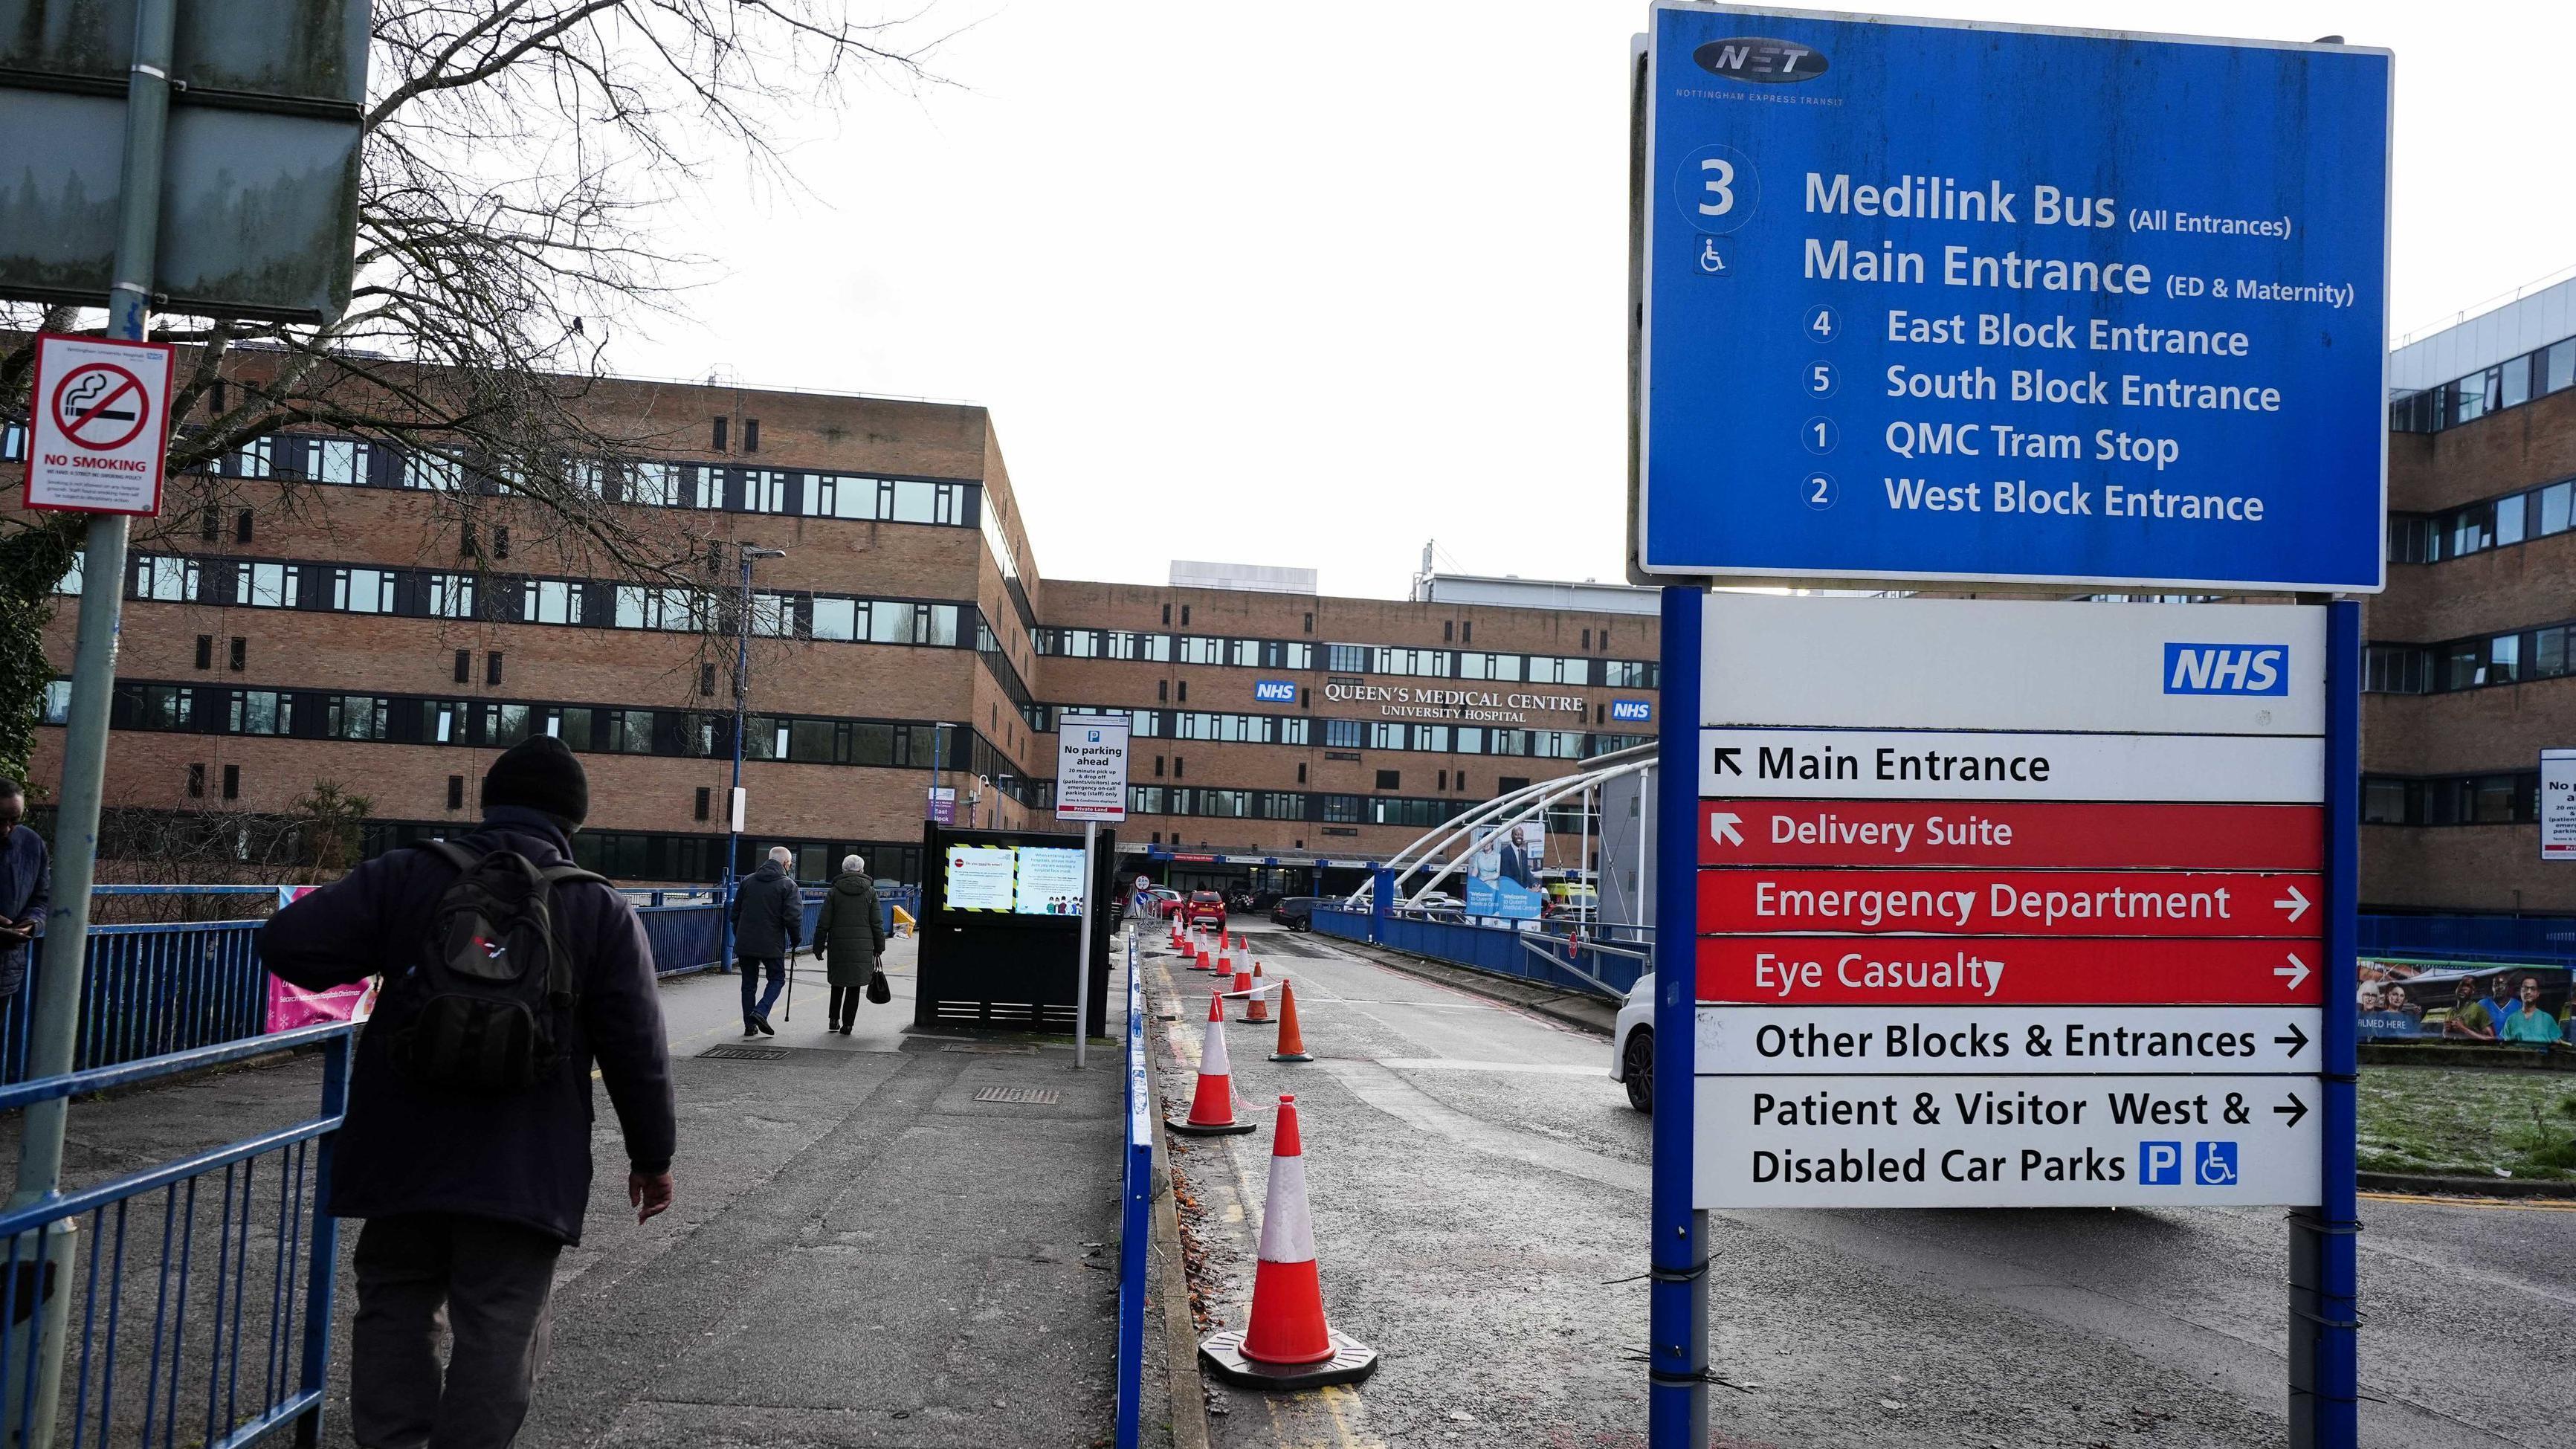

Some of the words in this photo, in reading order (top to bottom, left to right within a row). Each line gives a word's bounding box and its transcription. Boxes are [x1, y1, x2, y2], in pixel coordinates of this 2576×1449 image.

[1715, 45, 1810, 73] NET
[1676, 88, 1744, 100] NOTTINGHAM
[1749, 94, 1796, 104] EXPRESS
[1801, 97, 1844, 106] TRANSIT
[1699, 158, 1734, 216] 3
[1806, 172, 2017, 223] Medilink
[2034, 185, 2115, 228] Bus
[2129, 208, 2167, 233] (All
[2175, 212, 2291, 240] Entrances)
[1804, 238, 1924, 283] Main
[1944, 245, 2151, 294] Entrance
[2166, 274, 2204, 299] (ED
[2212, 278, 2228, 298] &
[2236, 280, 2354, 309] Maternity)
[1813, 311, 1831, 335] 4
[1888, 310, 1965, 344] East
[1978, 313, 2076, 349] Block
[2090, 319, 2249, 356] Entrance
[1814, 367, 1829, 392] 5
[1887, 364, 1996, 400] South
[2012, 369, 2108, 404] Block
[2123, 375, 2281, 412] Entrance
[45, 454, 68, 465] NO
[73, 456, 146, 472] SMOKING
[1814, 422, 1825, 447] 1
[1885, 421, 1979, 459] QMC
[1990, 425, 2081, 459] Tram
[2096, 429, 2179, 471] Stop
[1811, 478, 1827, 503] 2
[1884, 477, 1981, 512] West
[1994, 480, 2092, 515] Block
[2105, 485, 2264, 521] Entrance
[2171, 649, 2281, 691] NHS
[1256, 683, 1294, 699] NHS
[1325, 683, 1409, 702] QUEEN'S
[1415, 688, 1502, 708] MEDICAL
[1507, 693, 1584, 711] CENTRE
[1381, 706, 1462, 720] UNIVERSITY
[1465, 709, 1526, 723] HOSPITAL
[1613, 703, 1649, 718] NHS
[1065, 746, 1079, 754] No
[1082, 746, 1122, 758] parking
[1077, 758, 1109, 766] ahead
[1759, 746, 1858, 780] Main
[1876, 748, 2050, 782] Entrance
[2549, 781, 2569, 790] No
[1772, 813, 1914, 853] Delivery
[1926, 816, 2012, 846] Suite
[1757, 882, 1976, 926] Emergency
[1991, 883, 2230, 926] Department
[1756, 953, 1822, 997] Eye
[1837, 952, 2005, 997] Casualty
[280, 995, 298, 1003] Search
[1756, 1022, 1873, 1058] Other
[1886, 1022, 2010, 1058] Blocks
[2025, 1024, 2053, 1057] &
[2066, 1024, 2256, 1057] Entrances
[2386, 1020, 2406, 1030] HERE
[1754, 1091, 1897, 1126] Patient
[1913, 1092, 1940, 1125] &
[1954, 1091, 2087, 1126] Visitor
[2108, 1093, 2208, 1125] West
[2223, 1092, 2250, 1125] &
[1753, 1148, 1925, 1184] Disabled
[1941, 1149, 2007, 1182] Car
[2021, 1146, 2125, 1181] Parks
[2149, 1145, 2176, 1182] P
